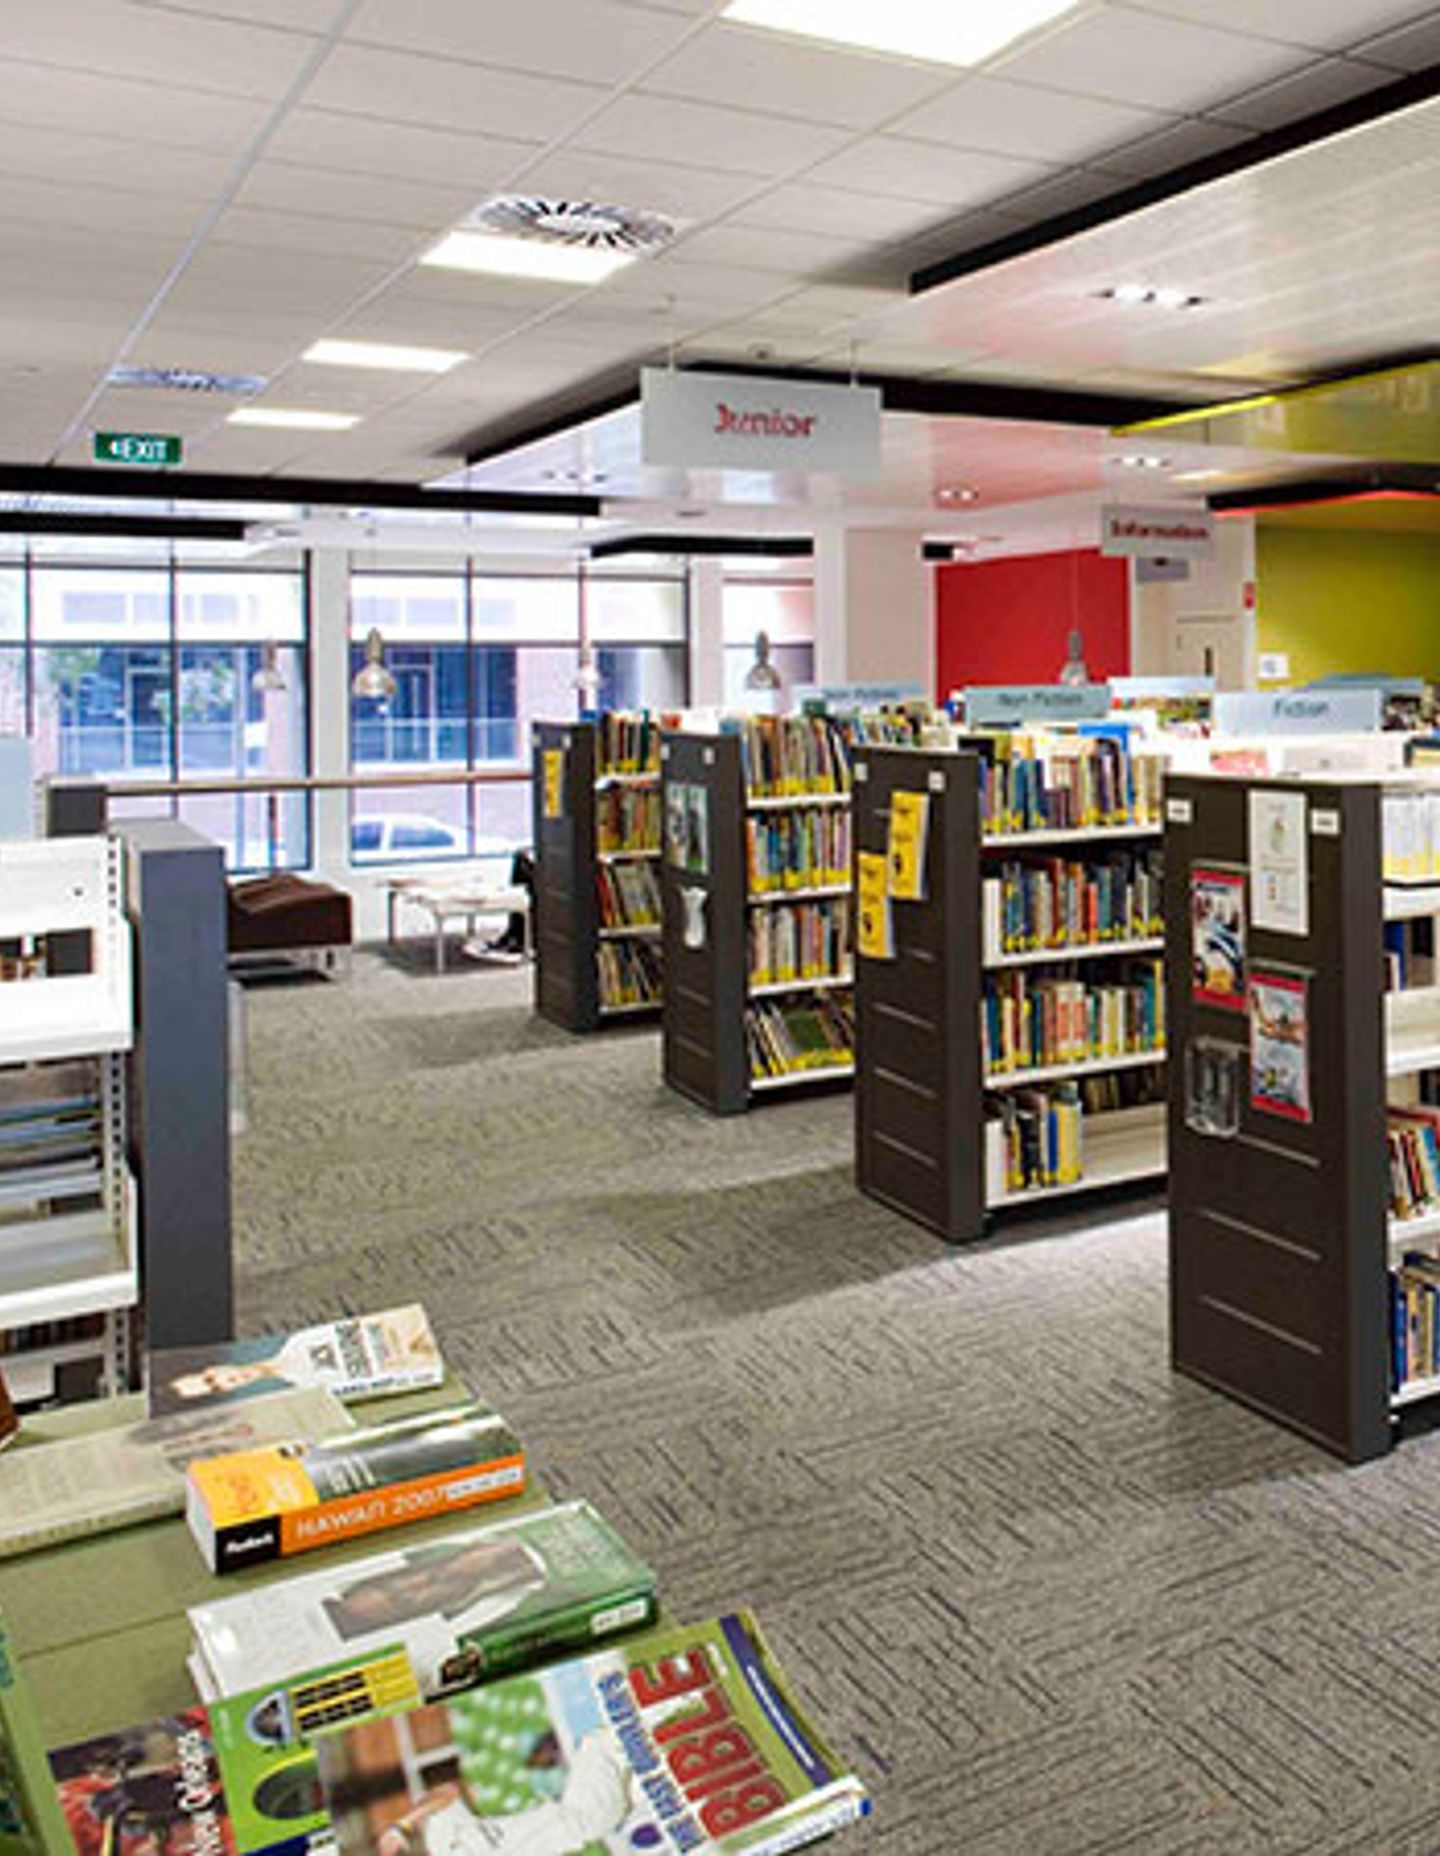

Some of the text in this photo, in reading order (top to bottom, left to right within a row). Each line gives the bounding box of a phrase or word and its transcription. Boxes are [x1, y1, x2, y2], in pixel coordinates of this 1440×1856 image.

[714, 403, 815, 438] Junior
[123, 437, 168, 460] EXIT
[1110, 519, 1210, 540] Information
[1033, 691, 1084, 707] Fiction
[1273, 697, 1330, 718] Fiction
[626, 1648, 790, 1840] BIBLE
